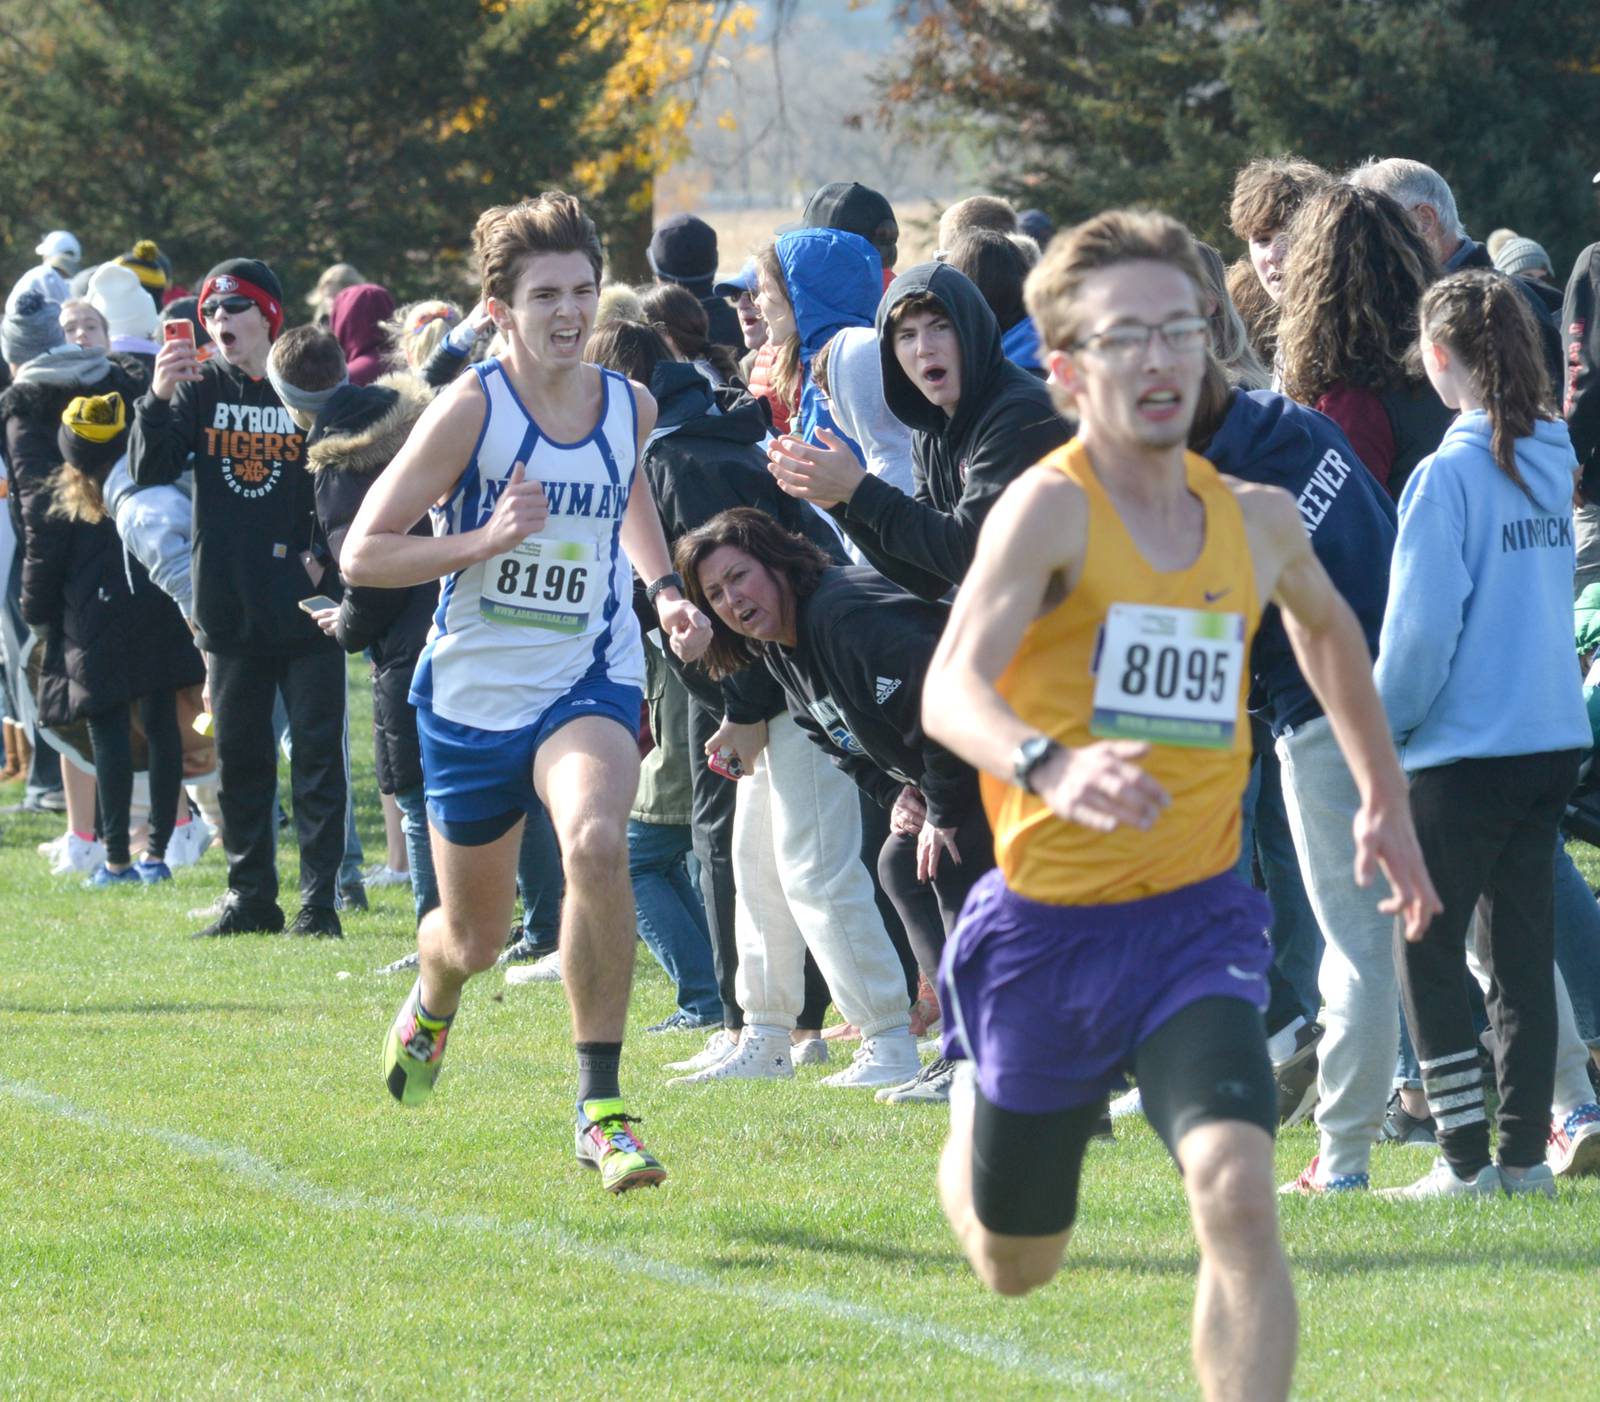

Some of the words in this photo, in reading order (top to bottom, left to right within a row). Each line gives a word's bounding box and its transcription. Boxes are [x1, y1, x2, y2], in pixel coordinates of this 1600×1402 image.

[213, 402, 296, 434] BYRON
[204, 426, 303, 462] TIGERS
[222, 457, 242, 493] CROSS
[243, 460, 282, 498] COUNTRY
[482, 479, 626, 518] NWMAN
[497, 559, 588, 604] 8196
[1120, 643, 1229, 704] 8095
